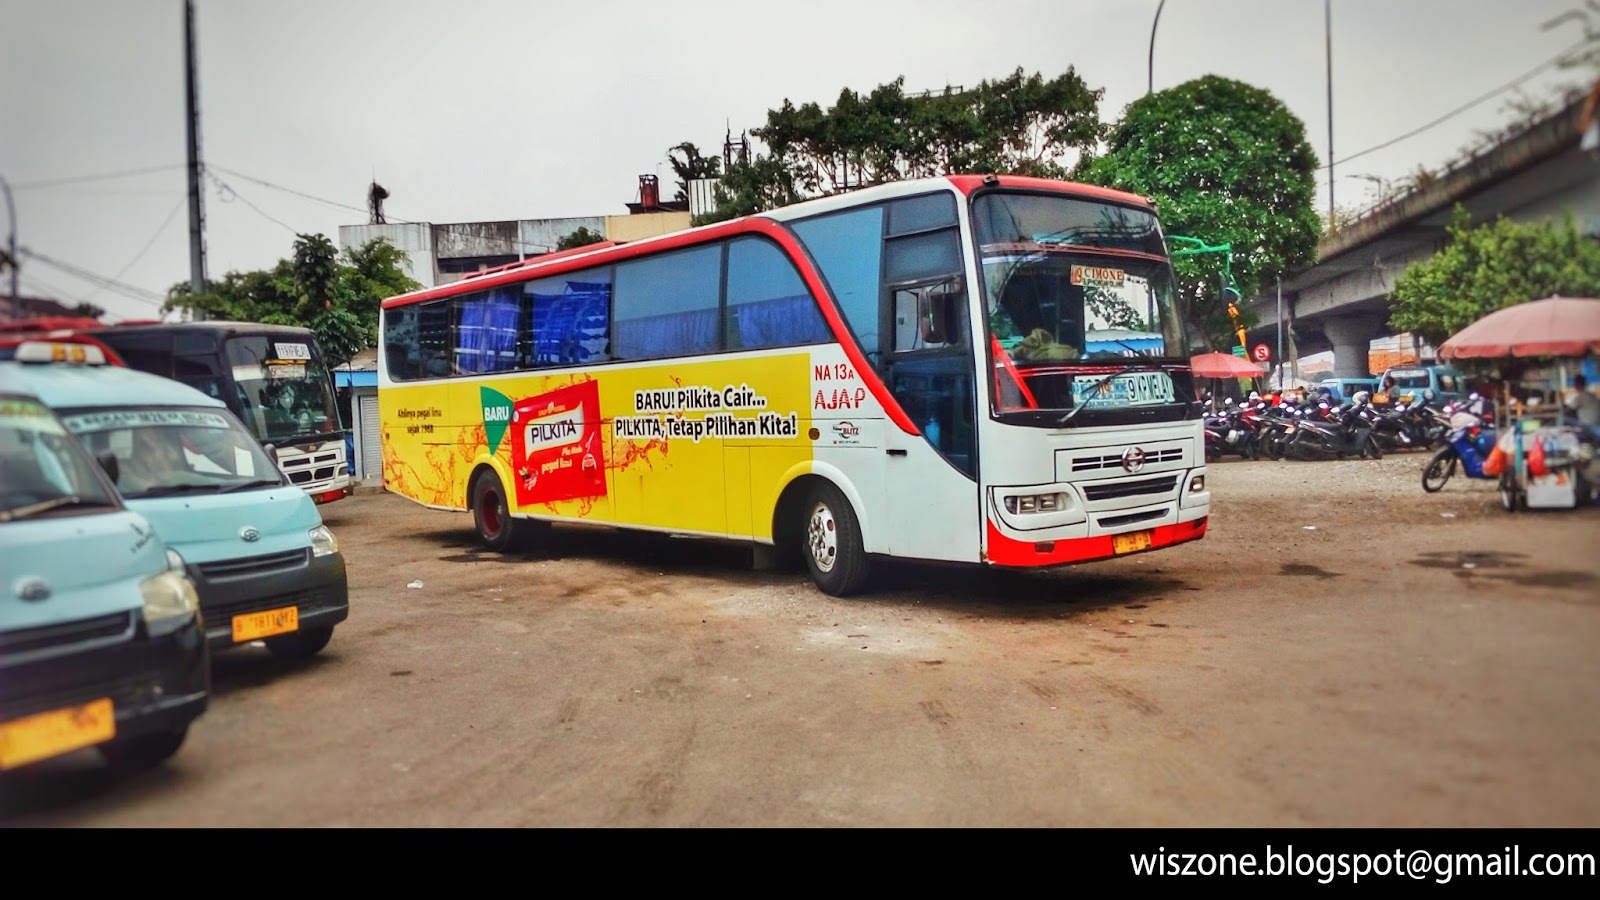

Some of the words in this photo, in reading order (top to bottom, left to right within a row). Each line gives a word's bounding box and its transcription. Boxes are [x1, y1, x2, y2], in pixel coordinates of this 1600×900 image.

[1084, 268, 1124, 280] CIMONE
[815, 365, 831, 381] NA
[636, 391, 675, 411] BARU!
[678, 389, 720, 409] Pilkita
[724, 386, 765, 407] Cair...
[484, 405, 509, 422] BARU
[531, 419, 577, 444] PILKITA
[616, 419, 665, 438] PILKITA,
[667, 418, 703, 441] Tetap
[706, 416, 756, 436] Pilihan
[760, 414, 797, 436] Kita!
[541, 458, 560, 475] pegal
